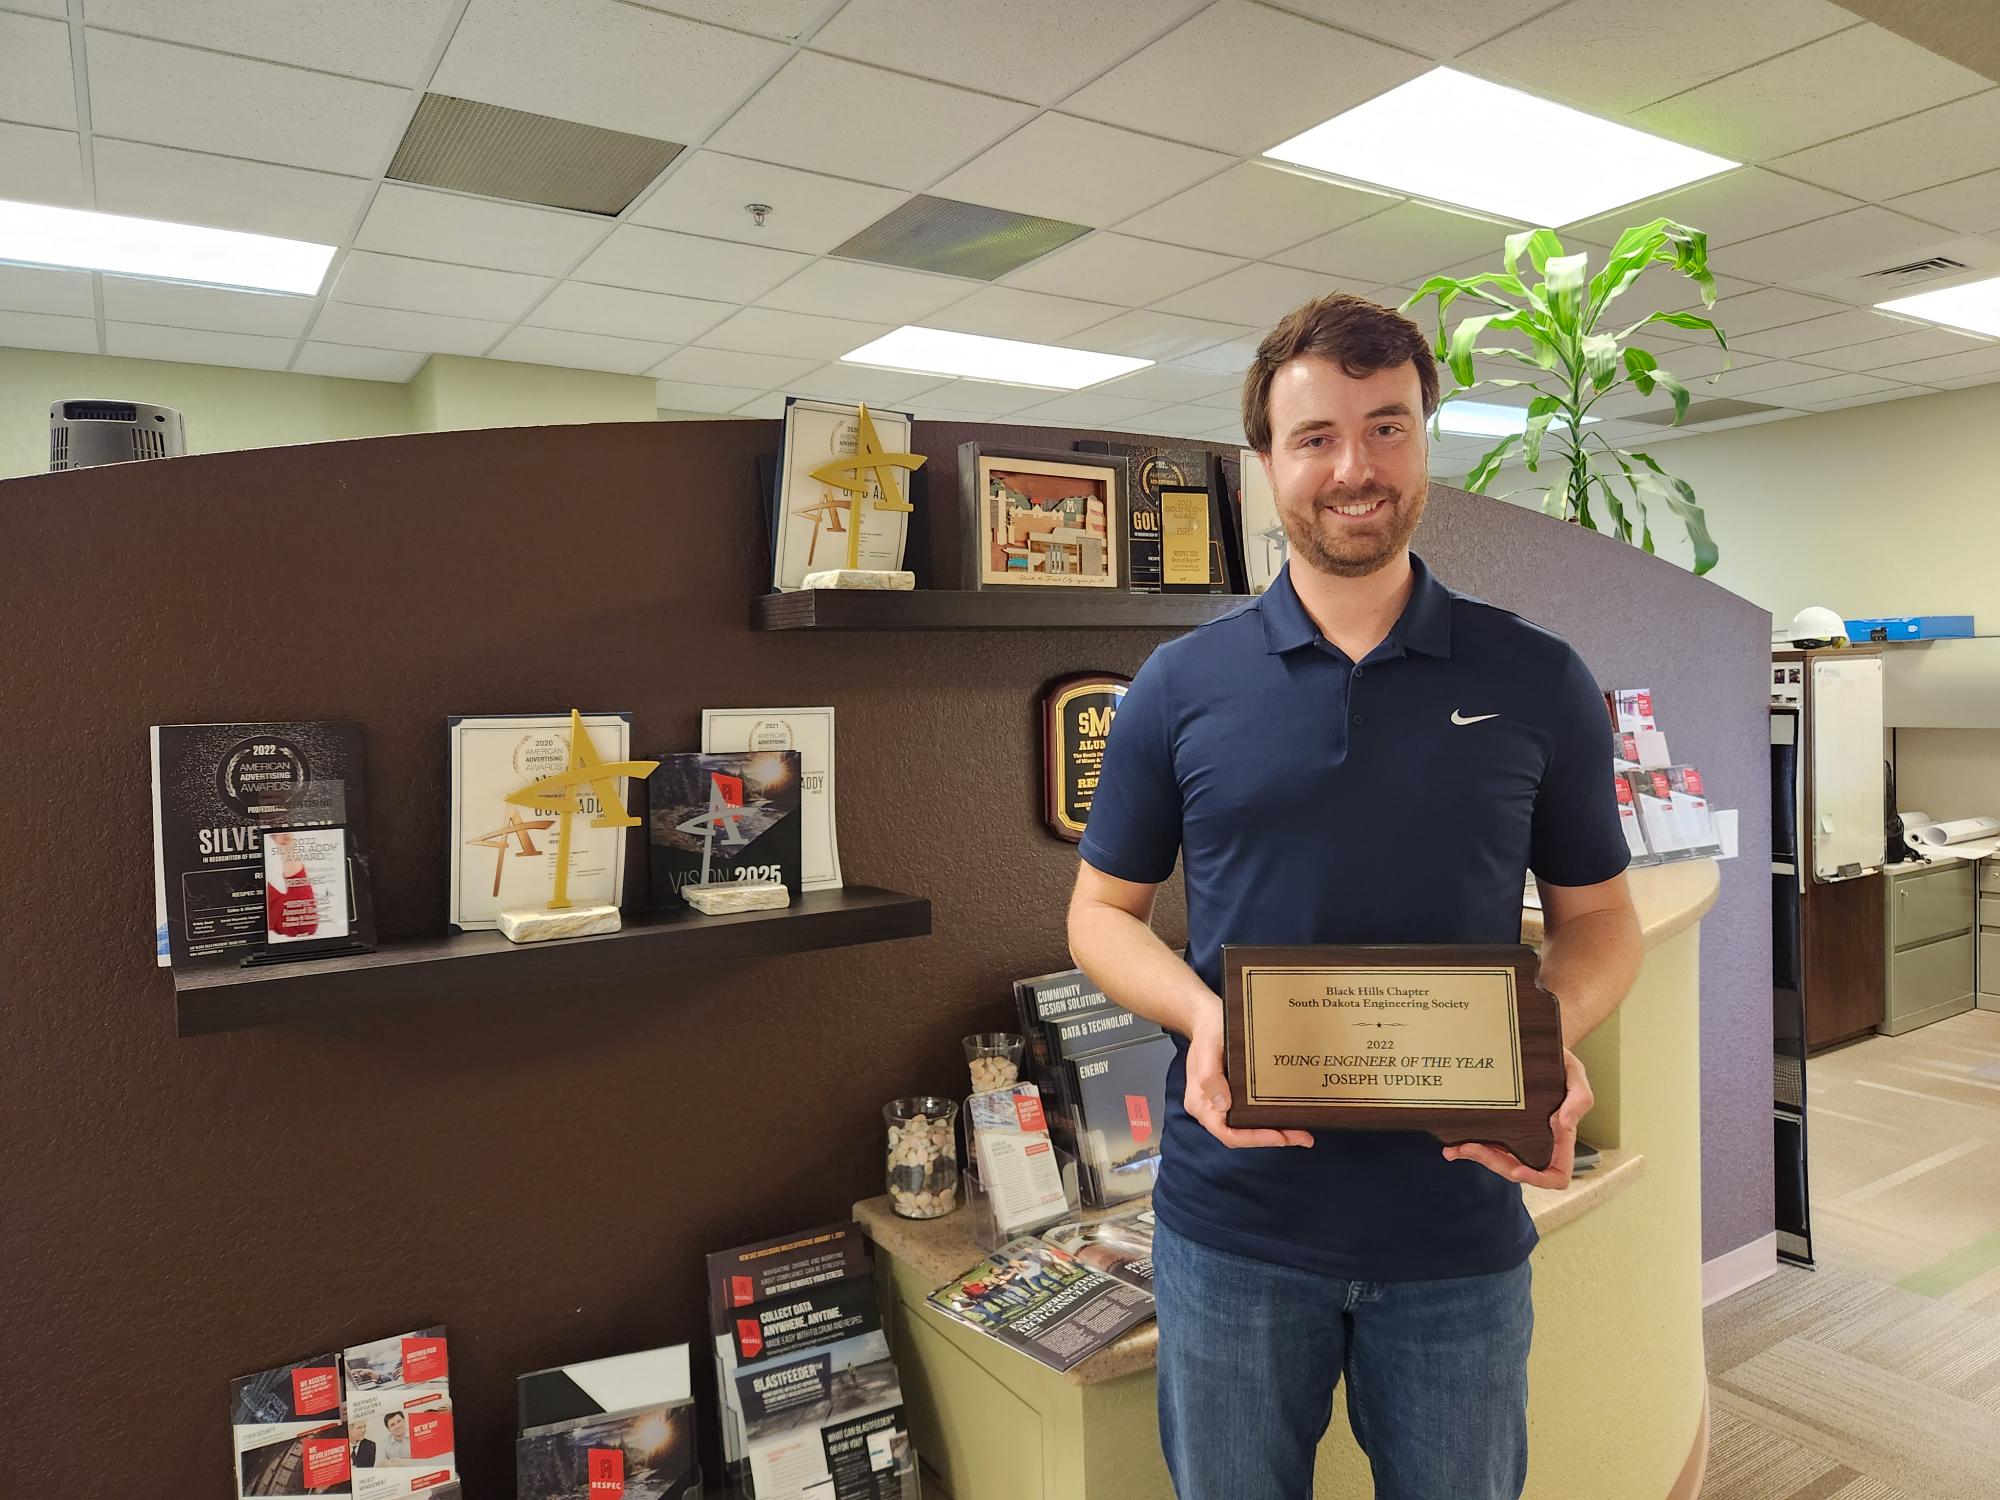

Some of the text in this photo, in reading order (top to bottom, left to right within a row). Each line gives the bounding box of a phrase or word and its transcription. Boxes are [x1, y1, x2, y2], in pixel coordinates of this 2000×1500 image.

[1133, 511, 1159, 531] GOL
[1078, 706, 1111, 737] SM
[253, 745, 277, 756] 2022
[1078, 740, 1106, 750] ALU
[240, 762, 290, 772] AMERICAN
[526, 763, 563, 771] AWARDS
[240, 772, 291, 781] ADVERTISING
[240, 781, 291, 792] AWARDS
[801, 776, 824, 790] ADDY
[199, 826, 260, 854] SILVE
[272, 845, 304, 856] SILVER
[209, 854, 241, 862] RECOGNITION
[284, 853, 325, 862] AWARD
[734, 864, 781, 884] 2025
[1037, 984, 1081, 1003] COMMUNITY
[1326, 986, 1430, 998] Black Hills Chapter
[1039, 992, 1106, 1017] DESIGN SOLUTIONS
[1288, 999, 1469, 1010] South Dakota Engineering Society
[1061, 1013, 1133, 1040] DATA & TECHNOLOGY
[1366, 1040, 1394, 1050] 2022
[1273, 1055, 1495, 1069] YOUNG ENGINEER OF THE YEAR
[1080, 1060, 1109, 1079] ENERGY
[1322, 1073, 1442, 1087] JOSEPH UPDIKE
[776, 1283, 790, 1293] TEAM
[760, 1301, 813, 1323] COLLECT DATA
[299, 1380, 308, 1388] WE
[308, 1446, 318, 1454] WE
[592, 1482, 621, 1490] RESPEC
